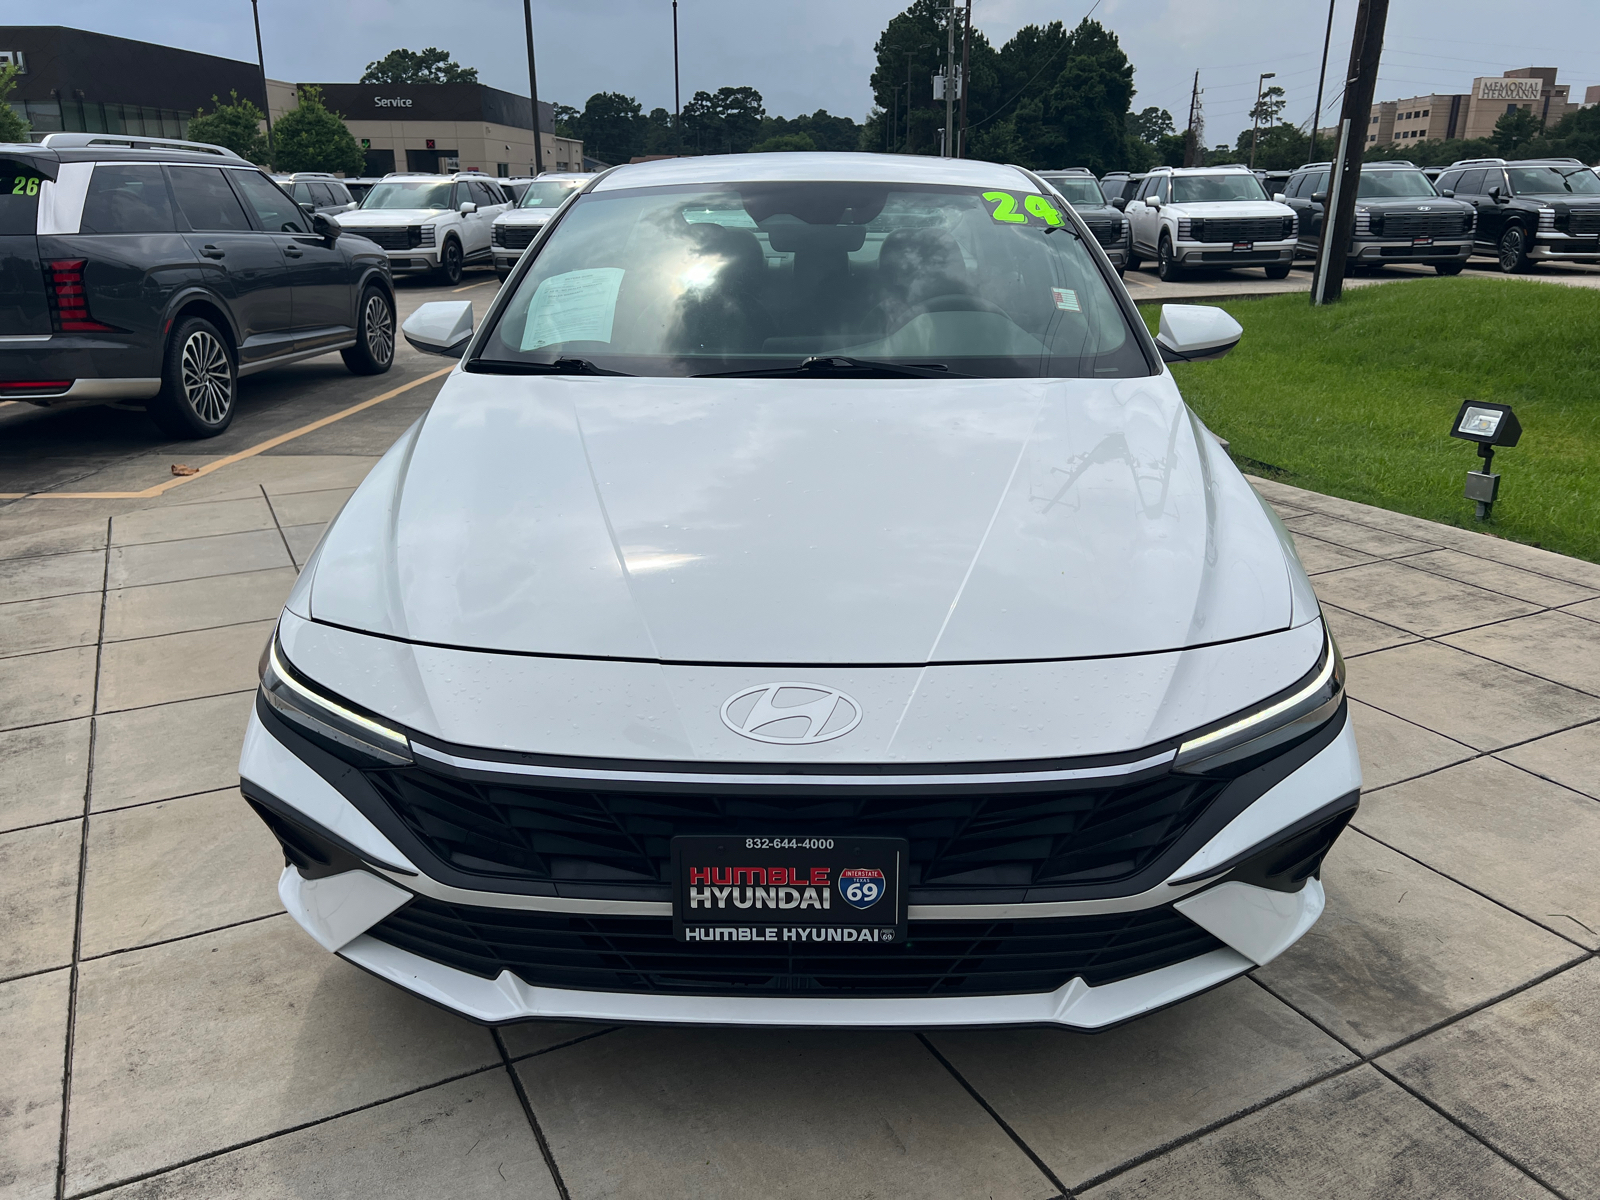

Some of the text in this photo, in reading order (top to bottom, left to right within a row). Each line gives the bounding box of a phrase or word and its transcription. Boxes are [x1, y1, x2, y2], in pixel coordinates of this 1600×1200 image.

[1482, 89, 1538, 98] HERMANN
[1484, 81, 1539, 91] MEMORIAL
[374, 96, 413, 107] Service
[12, 176, 39, 196] 26
[982, 191, 1065, 227] 24
[745, 838, 834, 849] 832-644-4000
[690, 867, 830, 885] HUMBLE
[690, 887, 830, 909] HYUNDAI
[846, 883, 878, 902] 69
[685, 928, 778, 941] HUMBLE
[783, 928, 879, 942] HYUNDAI
